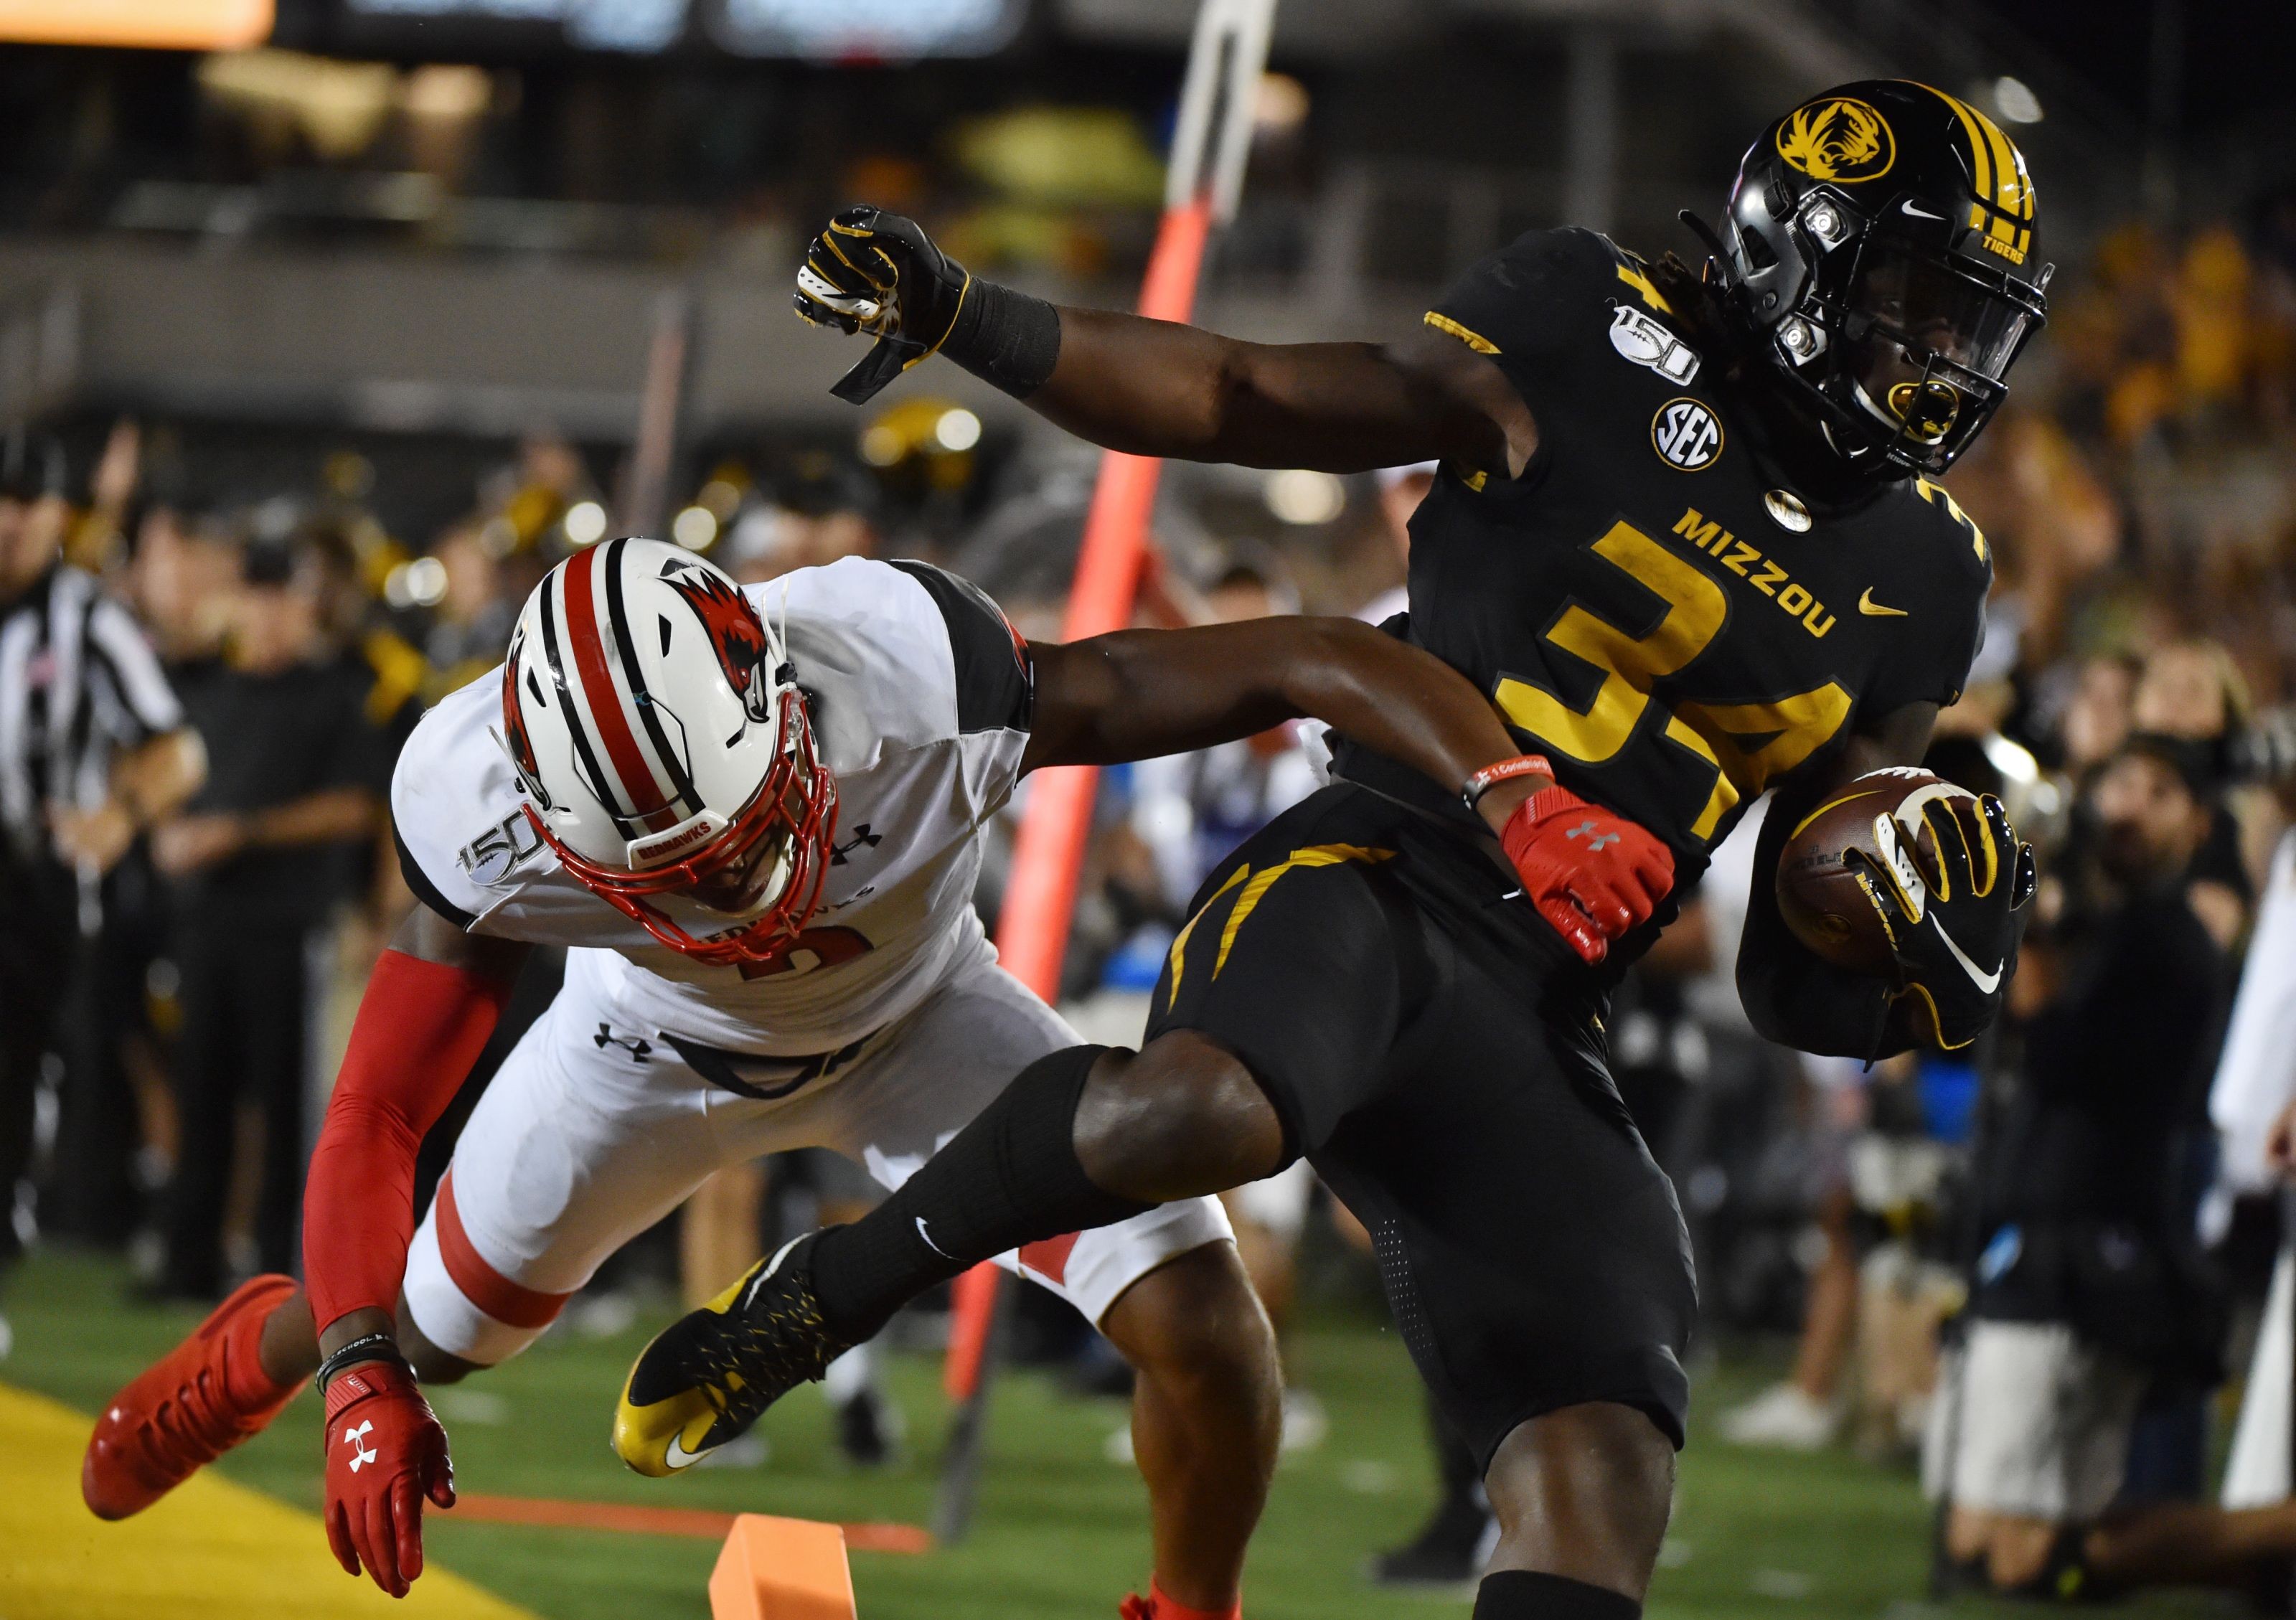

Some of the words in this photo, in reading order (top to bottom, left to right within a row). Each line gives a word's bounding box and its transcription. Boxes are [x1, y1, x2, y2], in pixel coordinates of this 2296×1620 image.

[1982, 235, 2025, 265] TIGERS
[1609, 304, 1703, 387] 150
[1657, 403, 1718, 466] SEC
[1671, 507, 1838, 639] MIZZOU
[1494, 519, 1853, 841] 34
[457, 806, 545, 886] 150
[637, 821, 712, 860] REDHAWKS
